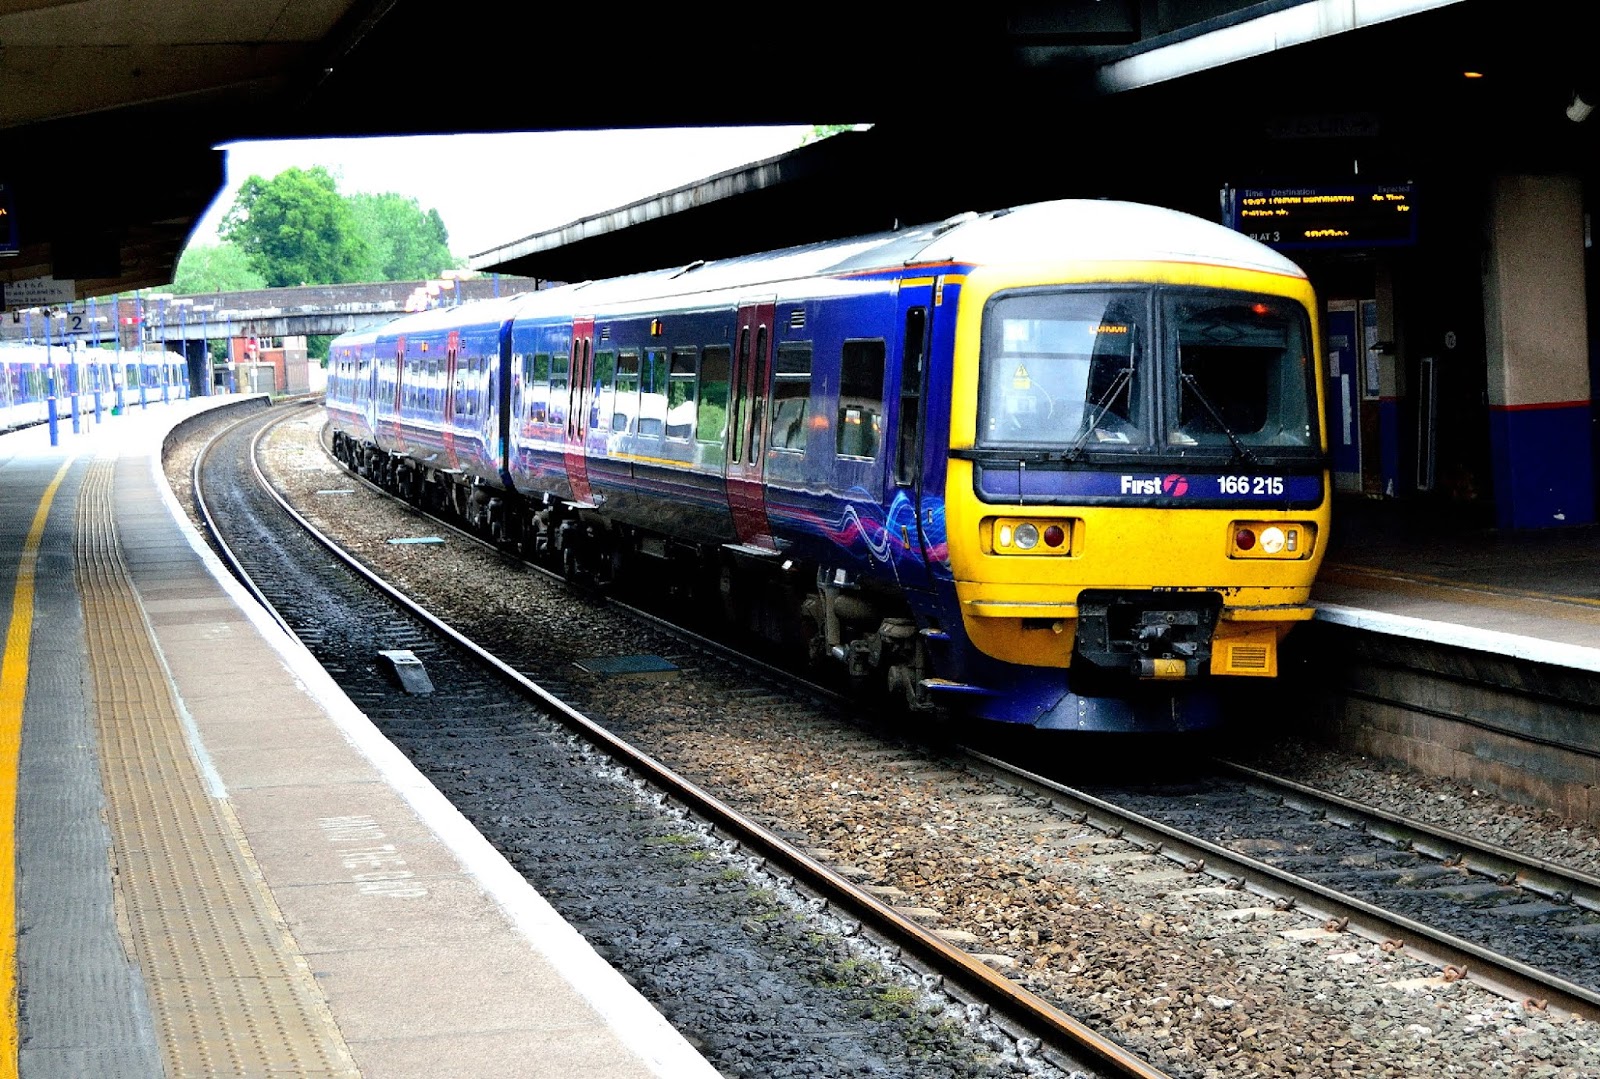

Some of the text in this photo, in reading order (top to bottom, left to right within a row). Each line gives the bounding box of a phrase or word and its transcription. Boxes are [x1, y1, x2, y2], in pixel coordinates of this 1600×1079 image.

[1271, 189, 1315, 197] Destination
[1273, 231, 1281, 242] 3
[72, 316, 82, 330] 2
[1121, 475, 1161, 494] First
[1217, 476, 1283, 495] 166 215
